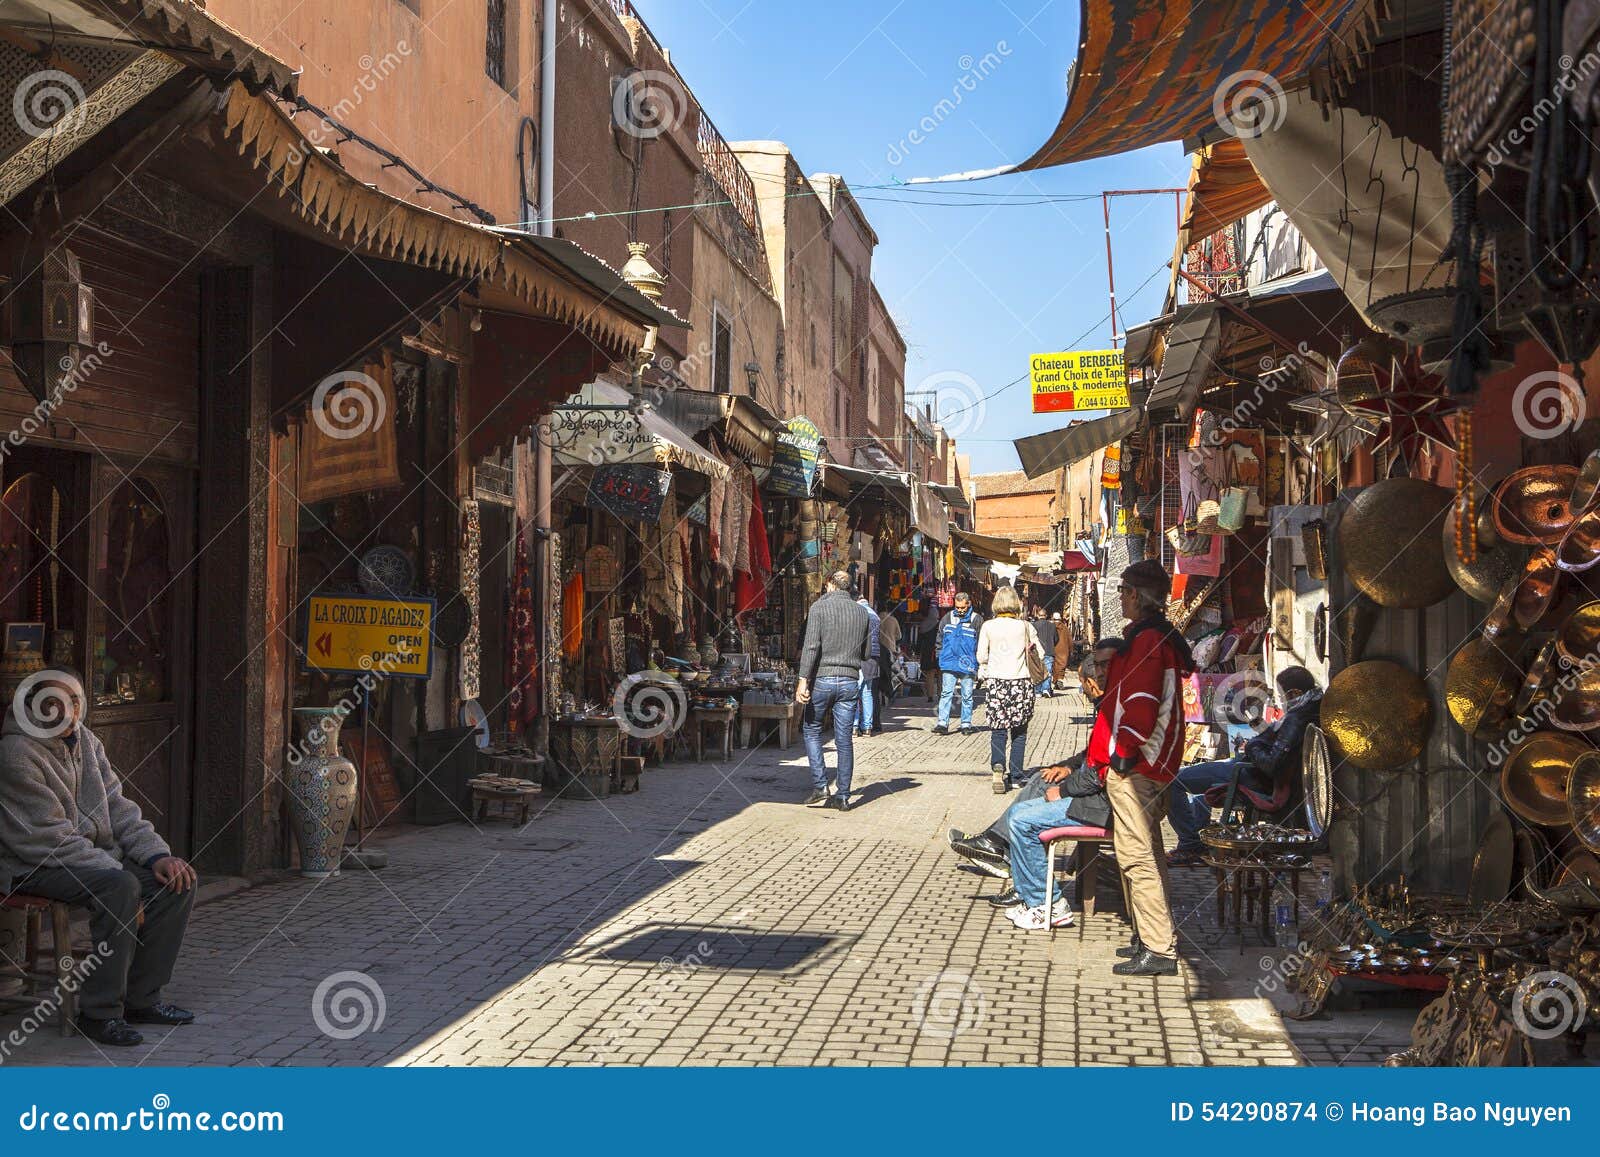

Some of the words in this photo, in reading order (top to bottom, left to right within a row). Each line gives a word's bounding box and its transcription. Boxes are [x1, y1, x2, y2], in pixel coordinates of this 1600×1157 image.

[1033, 358, 1074, 371] Chateau
[1034, 370, 1060, 383] Grand
[1064, 369, 1089, 381] Choix
[1091, 369, 1103, 379] de
[1036, 383, 1070, 393] Anciens
[314, 603, 329, 622] LA
[332, 604, 367, 625] CROIX
[369, 606, 426, 628] D'AGADEZ
[388, 634, 422, 647] OPEN
[372, 650, 422, 665] OUVERT
